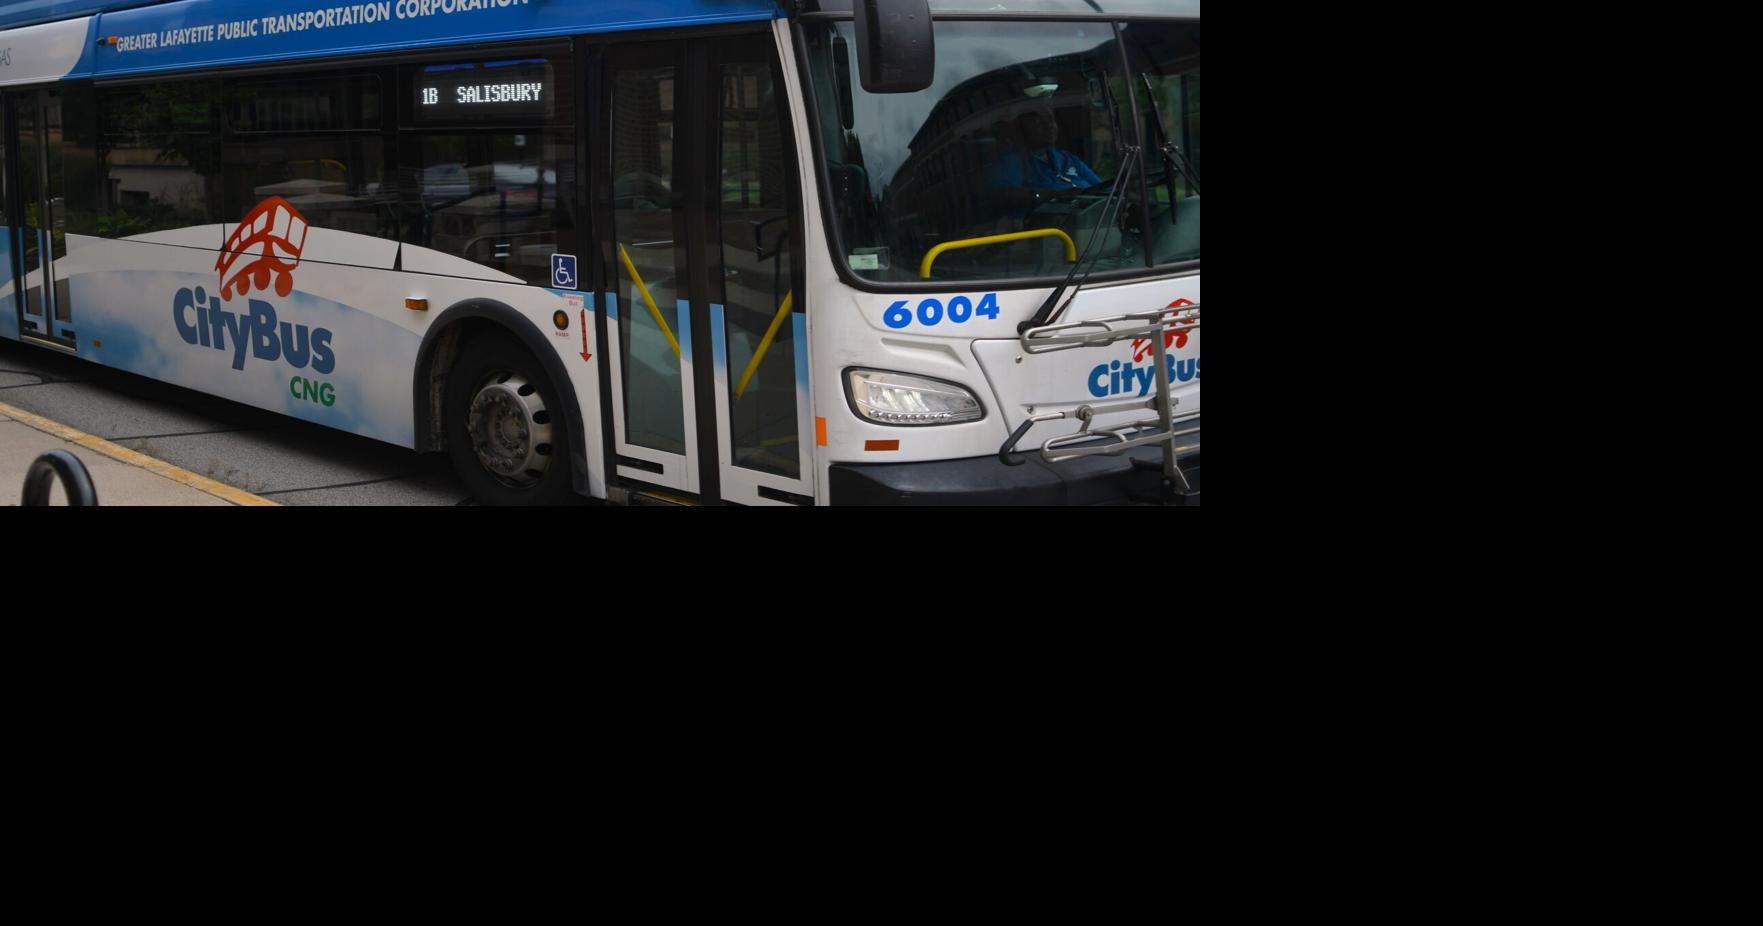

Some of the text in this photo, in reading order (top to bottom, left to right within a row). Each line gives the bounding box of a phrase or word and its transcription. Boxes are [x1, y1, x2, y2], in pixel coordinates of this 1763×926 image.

[117, 33, 157, 52] GREATER
[160, 24, 214, 47] LAFAYETTE
[218, 18, 258, 40] PUBLIC
[262, 1, 390, 35] TRANSPORTATION
[423, 82, 542, 105] 1B SALISBURY
[883, 292, 1000, 329] 6004
[173, 286, 336, 374] CityBus
[290, 375, 336, 407] CNG
